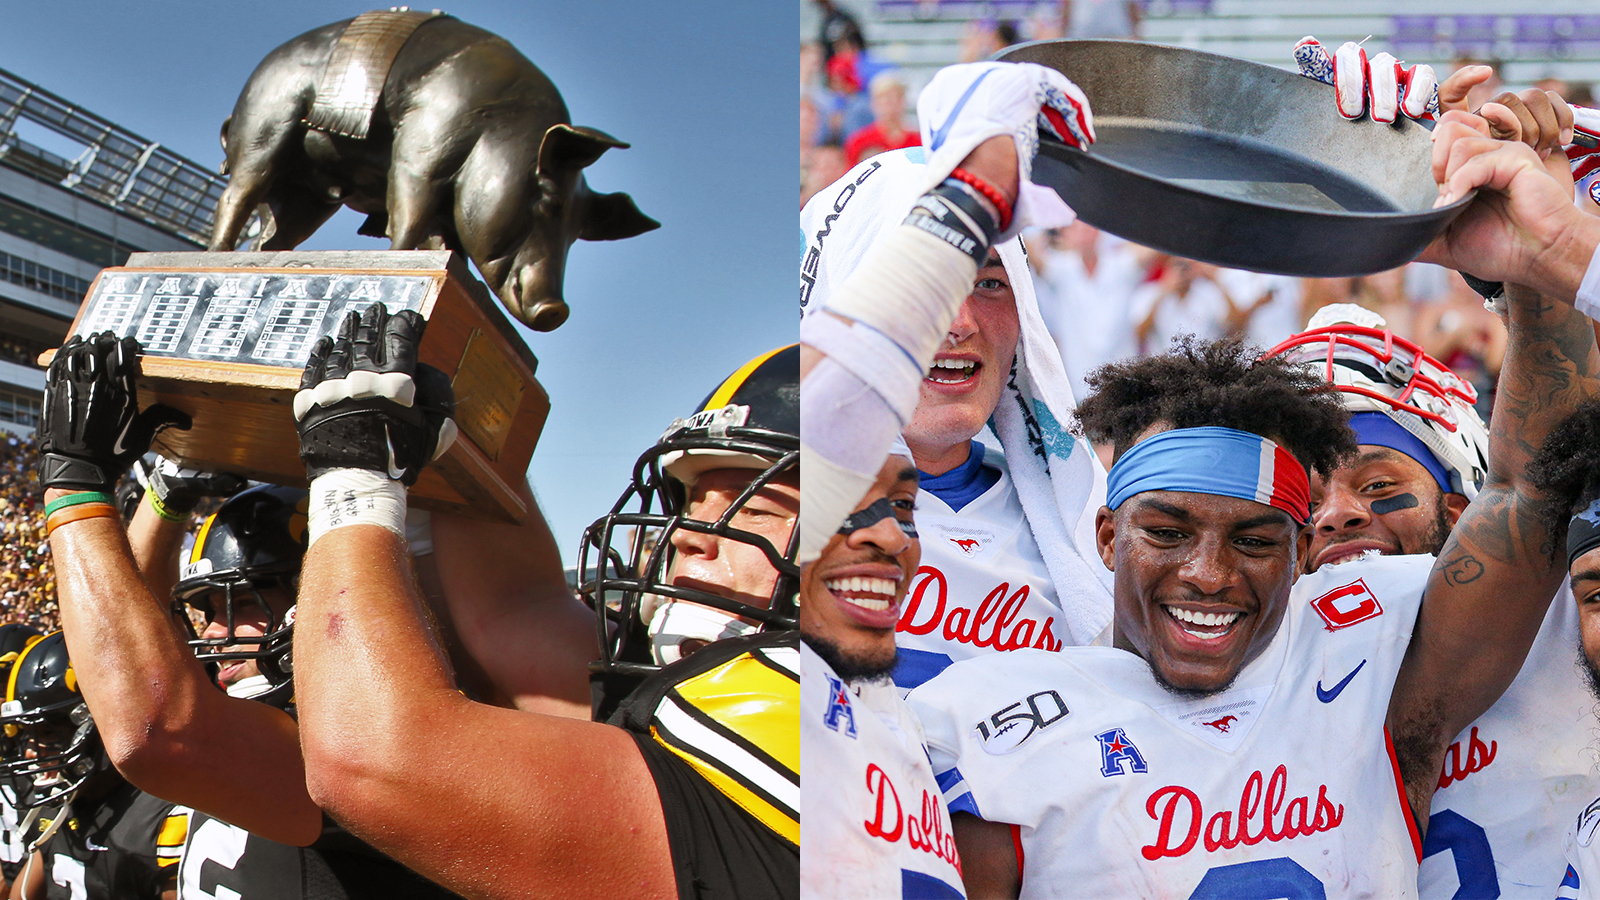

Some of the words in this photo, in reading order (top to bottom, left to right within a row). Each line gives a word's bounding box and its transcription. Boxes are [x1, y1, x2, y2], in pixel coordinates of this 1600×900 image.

[800, 161, 881, 321] POWER
[895, 565, 1062, 653] Dallas
[1316, 583, 1377, 625] C
[974, 689, 1070, 748] 150
[1094, 727, 1148, 778] A
[864, 762, 963, 882] Dalla
[1141, 763, 1345, 861] Dallas
